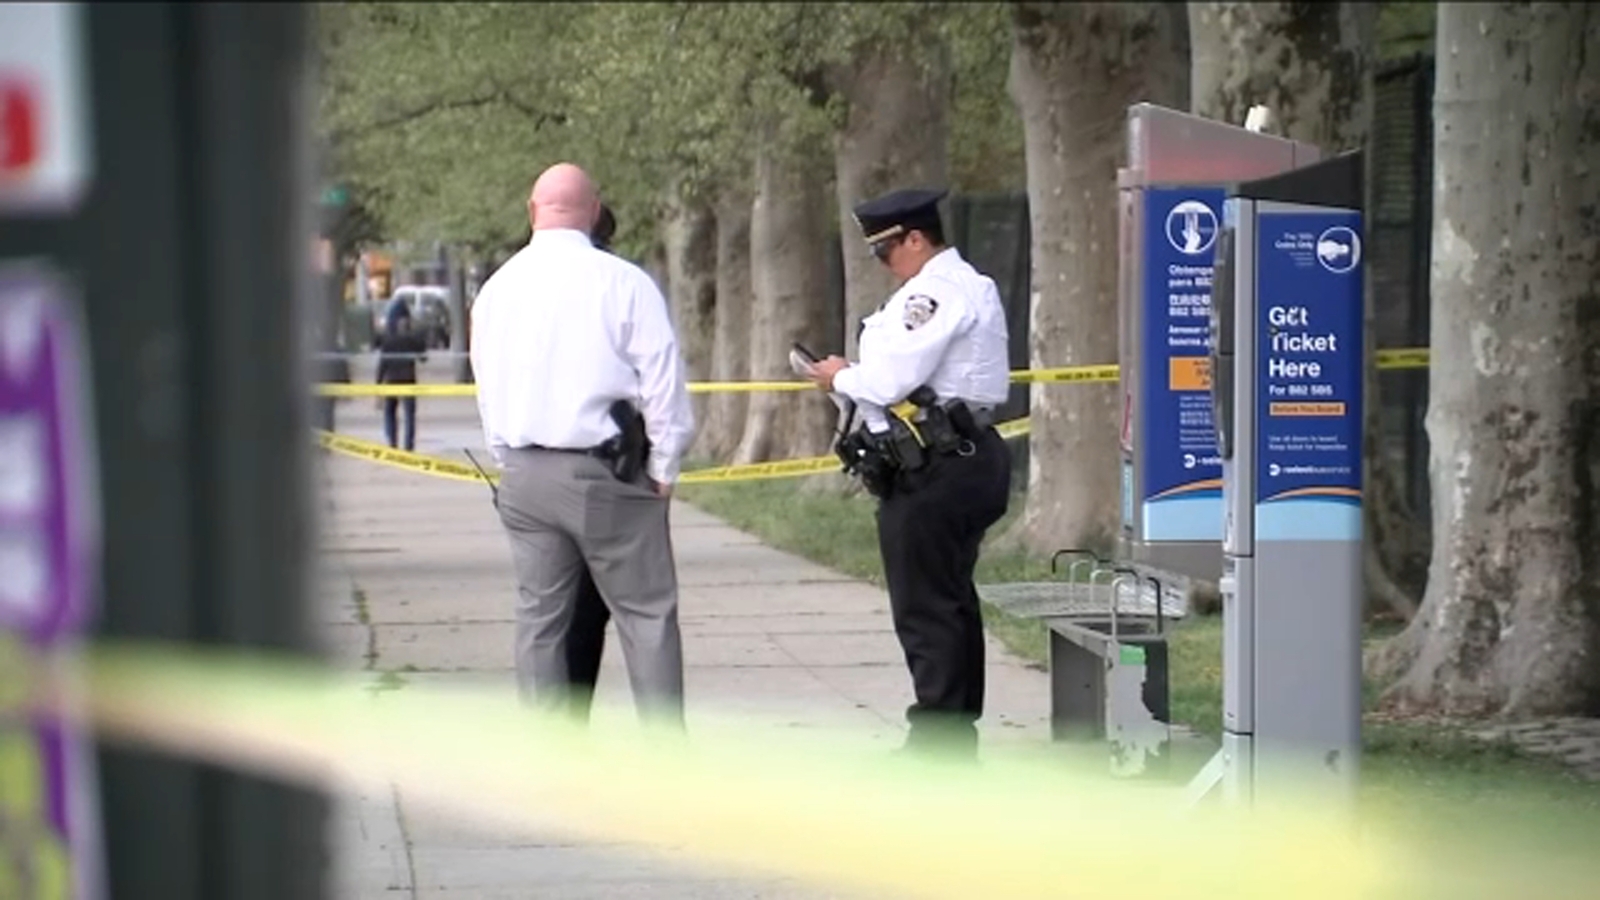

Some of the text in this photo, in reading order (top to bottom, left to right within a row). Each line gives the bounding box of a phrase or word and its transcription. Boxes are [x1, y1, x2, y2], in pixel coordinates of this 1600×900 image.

[1270, 331, 1337, 352] Ticket
[1268, 358, 1321, 379] Here
[1269, 384, 1286, 396] For
